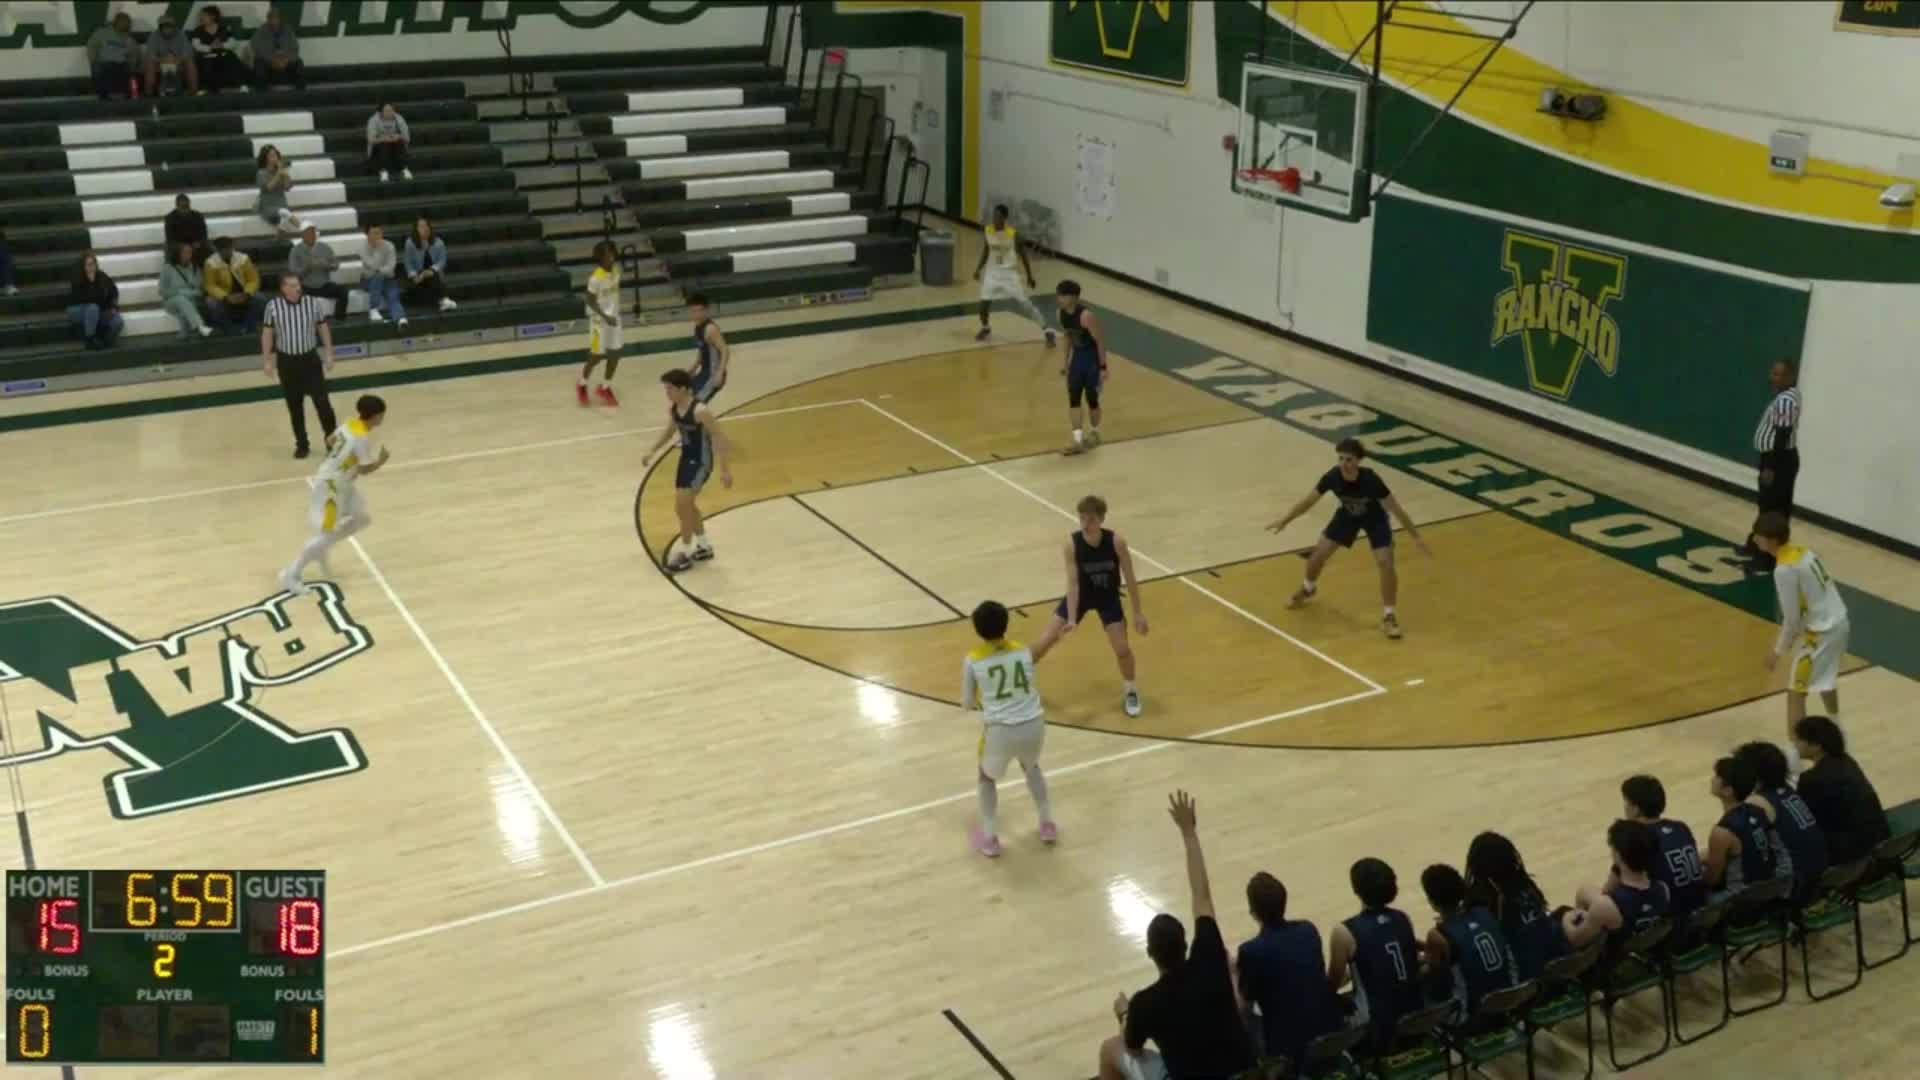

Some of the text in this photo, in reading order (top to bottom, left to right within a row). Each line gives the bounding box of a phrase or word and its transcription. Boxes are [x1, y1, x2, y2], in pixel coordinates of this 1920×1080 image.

[1491, 282, 1620, 376] RANCHO
[1170, 355, 1752, 585] VAQUEROS
[988, 660, 1030, 700] 24
[1664, 846, 1703, 887] 50
[1385, 941, 1407, 980] 1
[1474, 932, 1503, 972] 0
